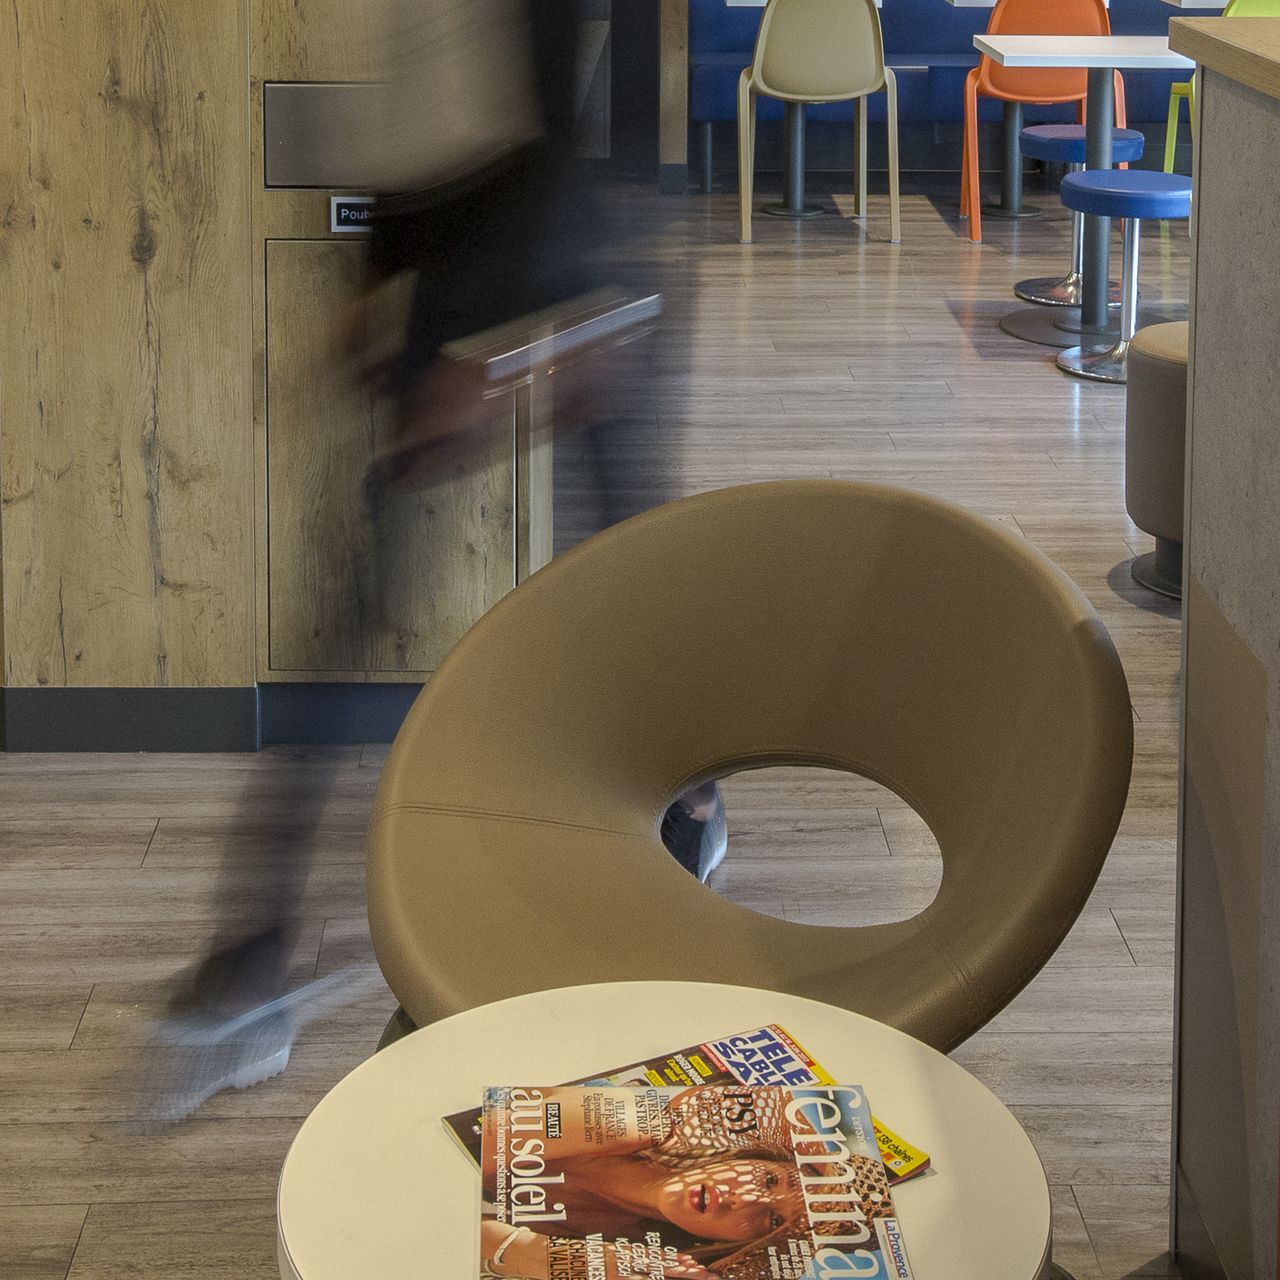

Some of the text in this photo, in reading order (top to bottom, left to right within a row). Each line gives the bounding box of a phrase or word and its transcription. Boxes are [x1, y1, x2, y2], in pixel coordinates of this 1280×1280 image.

[341, 208, 371, 220] Poub
[546, 1103, 562, 1138] BEAUTÉ
[605, 1110, 616, 1141] FRANCE
[615, 1101, 627, 1137] VILLAGES
[723, 1092, 760, 1140] PSY
[494, 1153, 510, 1187] questions
[509, 1088, 567, 1225] au soleil
[782, 1085, 883, 1280] femina
[549, 1249, 565, 1280] VALISE
[586, 1232, 606, 1280] VACANCES
[615, 1237, 631, 1277] KLAPISCH
[885, 1220, 908, 1278] La Provence
